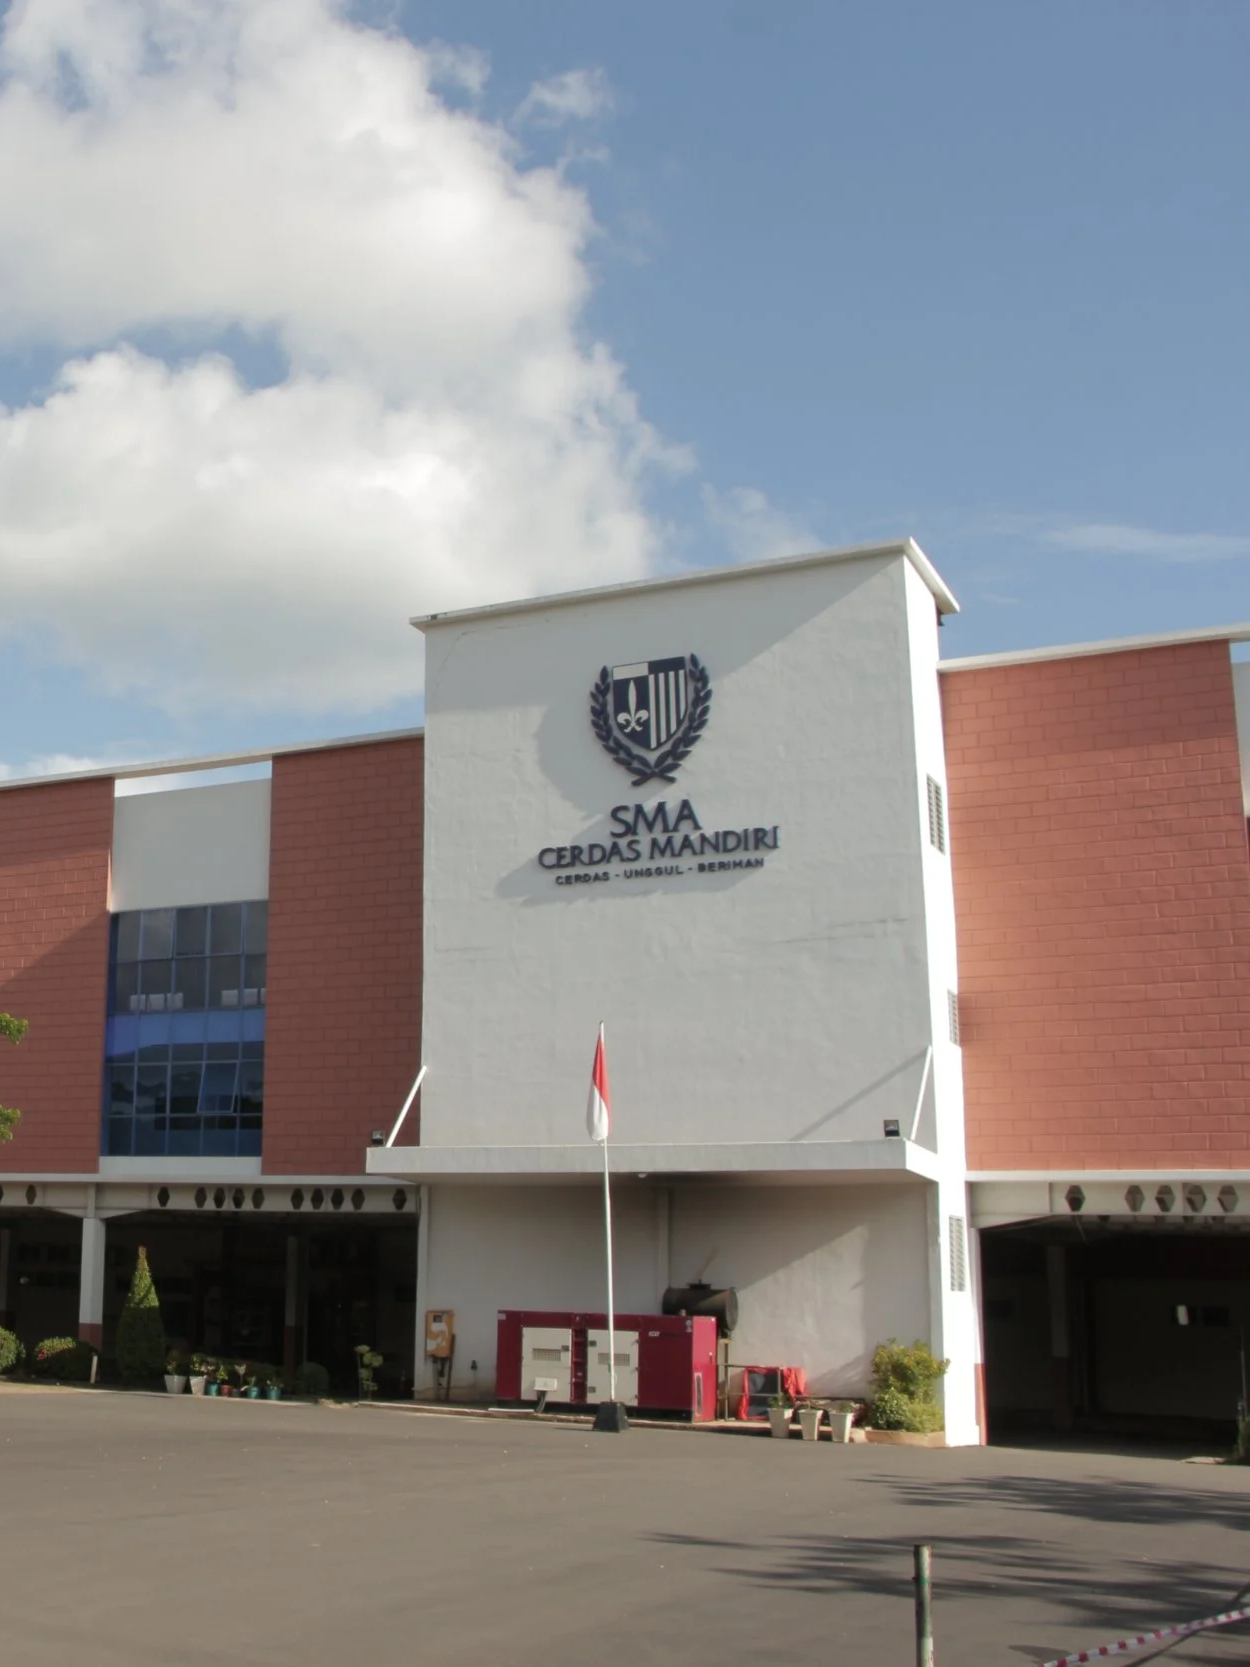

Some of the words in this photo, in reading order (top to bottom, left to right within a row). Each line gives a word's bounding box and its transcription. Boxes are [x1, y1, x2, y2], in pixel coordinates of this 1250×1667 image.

[610, 799, 702, 839] SMA
[538, 839, 641, 870] CERDAS
[649, 825, 780, 860] MANDIRI
[555, 871, 610, 885] CERDAS
[624, 866, 684, 879] UNGGUL
[698, 857, 764, 873] BERIMAN
